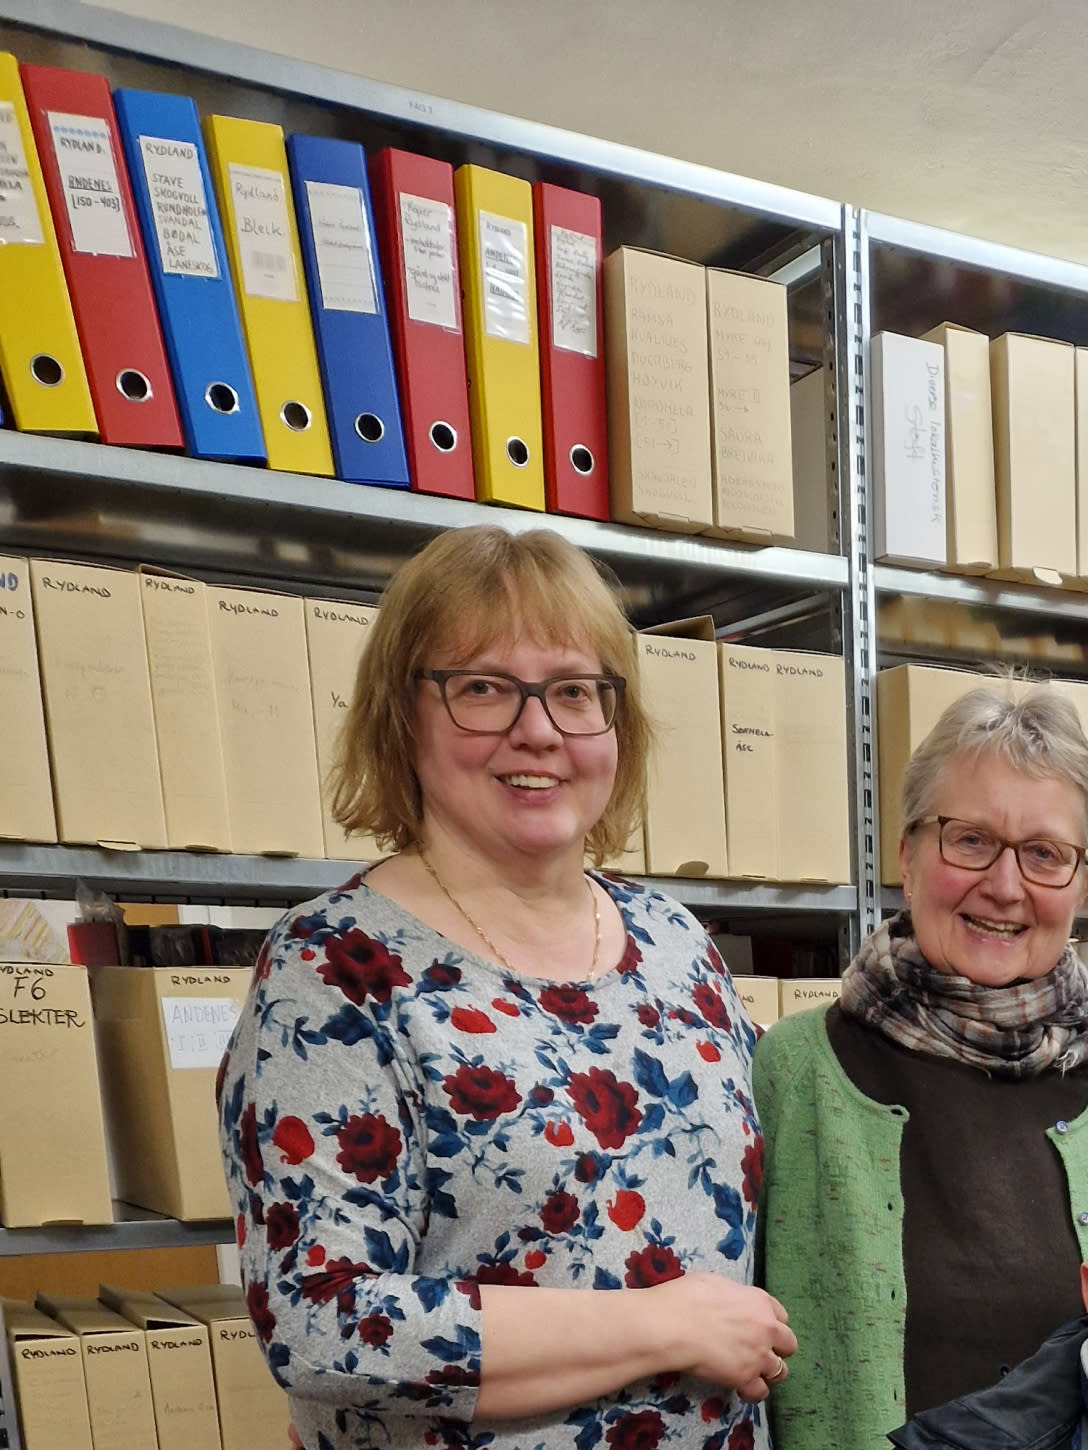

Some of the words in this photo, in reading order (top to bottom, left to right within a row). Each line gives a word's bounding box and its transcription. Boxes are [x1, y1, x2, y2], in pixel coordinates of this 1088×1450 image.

[145, 143, 194, 160] RYDLAND
[152, 174, 183, 189] STAVE
[42, 576, 112, 598] RYDLAND
[145, 577, 195, 595] RYDLAND
[218, 600, 279, 618] RYDLAND
[313, 607, 369, 626] RYDLAND
[645, 645, 696, 662] RYDLAND
[729, 657, 770, 672] RYDLAND
[776, 664, 824, 677] RYDLAND
[0, 966, 54, 977] YDLAND
[171, 975, 231, 985] RYDLAND
[14, 976, 46, 1000] F6
[220, 1329, 255, 1341] RYDL
[87, 1343, 139, 1355] RYDLAND
[152, 1338, 203, 1350] RYDLAND
[22, 1348, 77, 1360] RYDLAND
